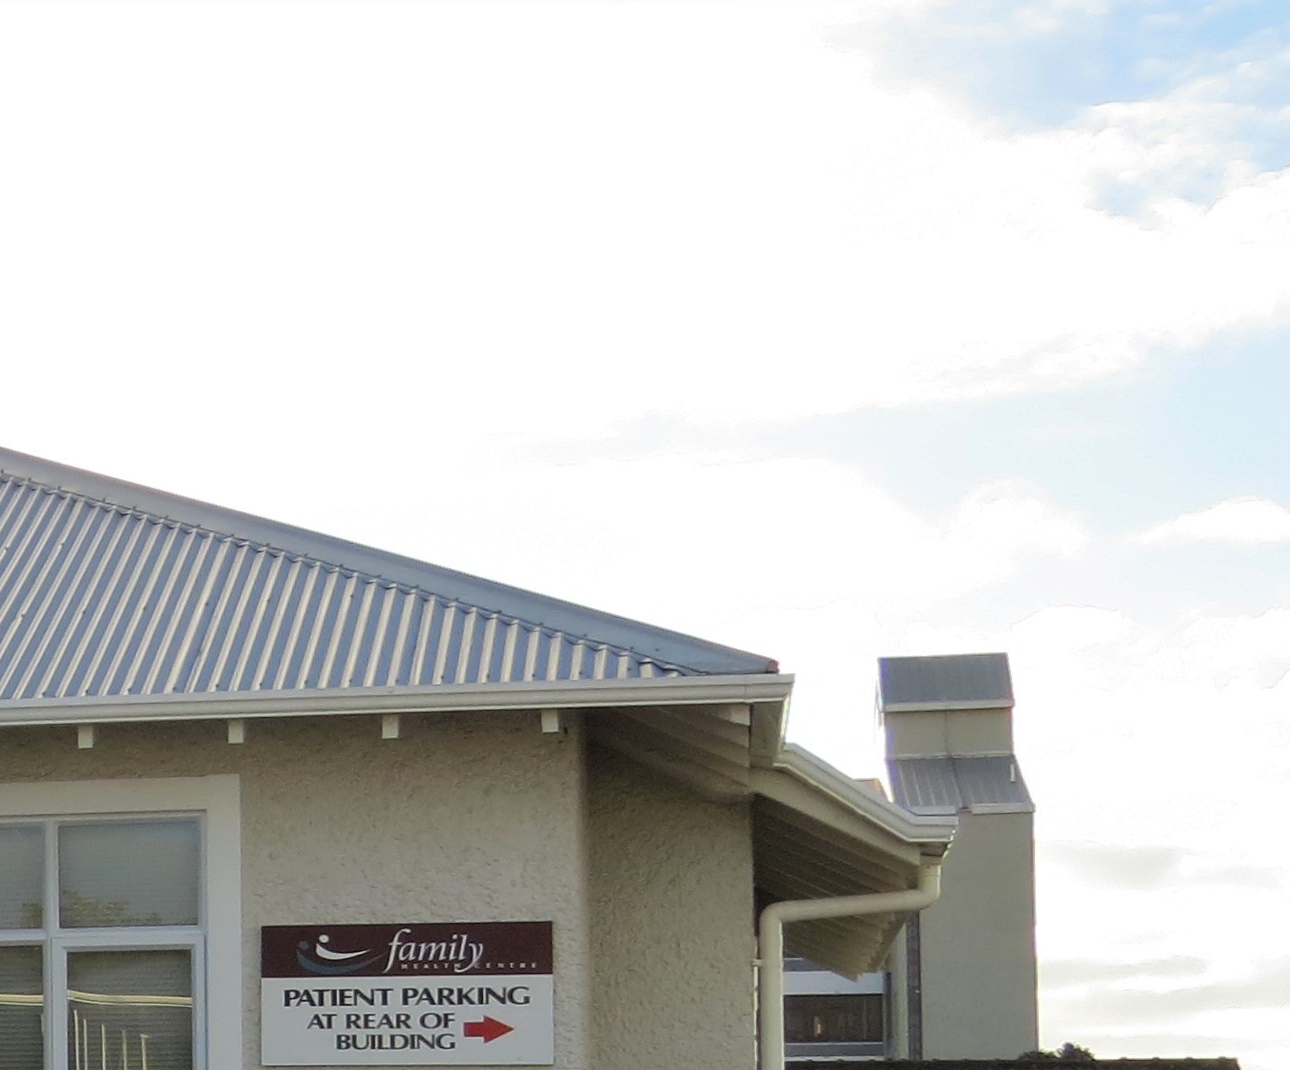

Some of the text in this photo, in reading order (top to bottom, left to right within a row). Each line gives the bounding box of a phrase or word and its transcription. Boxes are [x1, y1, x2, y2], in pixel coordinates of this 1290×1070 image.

[383, 928, 483, 974] family
[284, 986, 530, 1007] PATIENT PARKING
[307, 1012, 456, 1030] AT REAR OF
[336, 1033, 456, 1051] BUILDING
